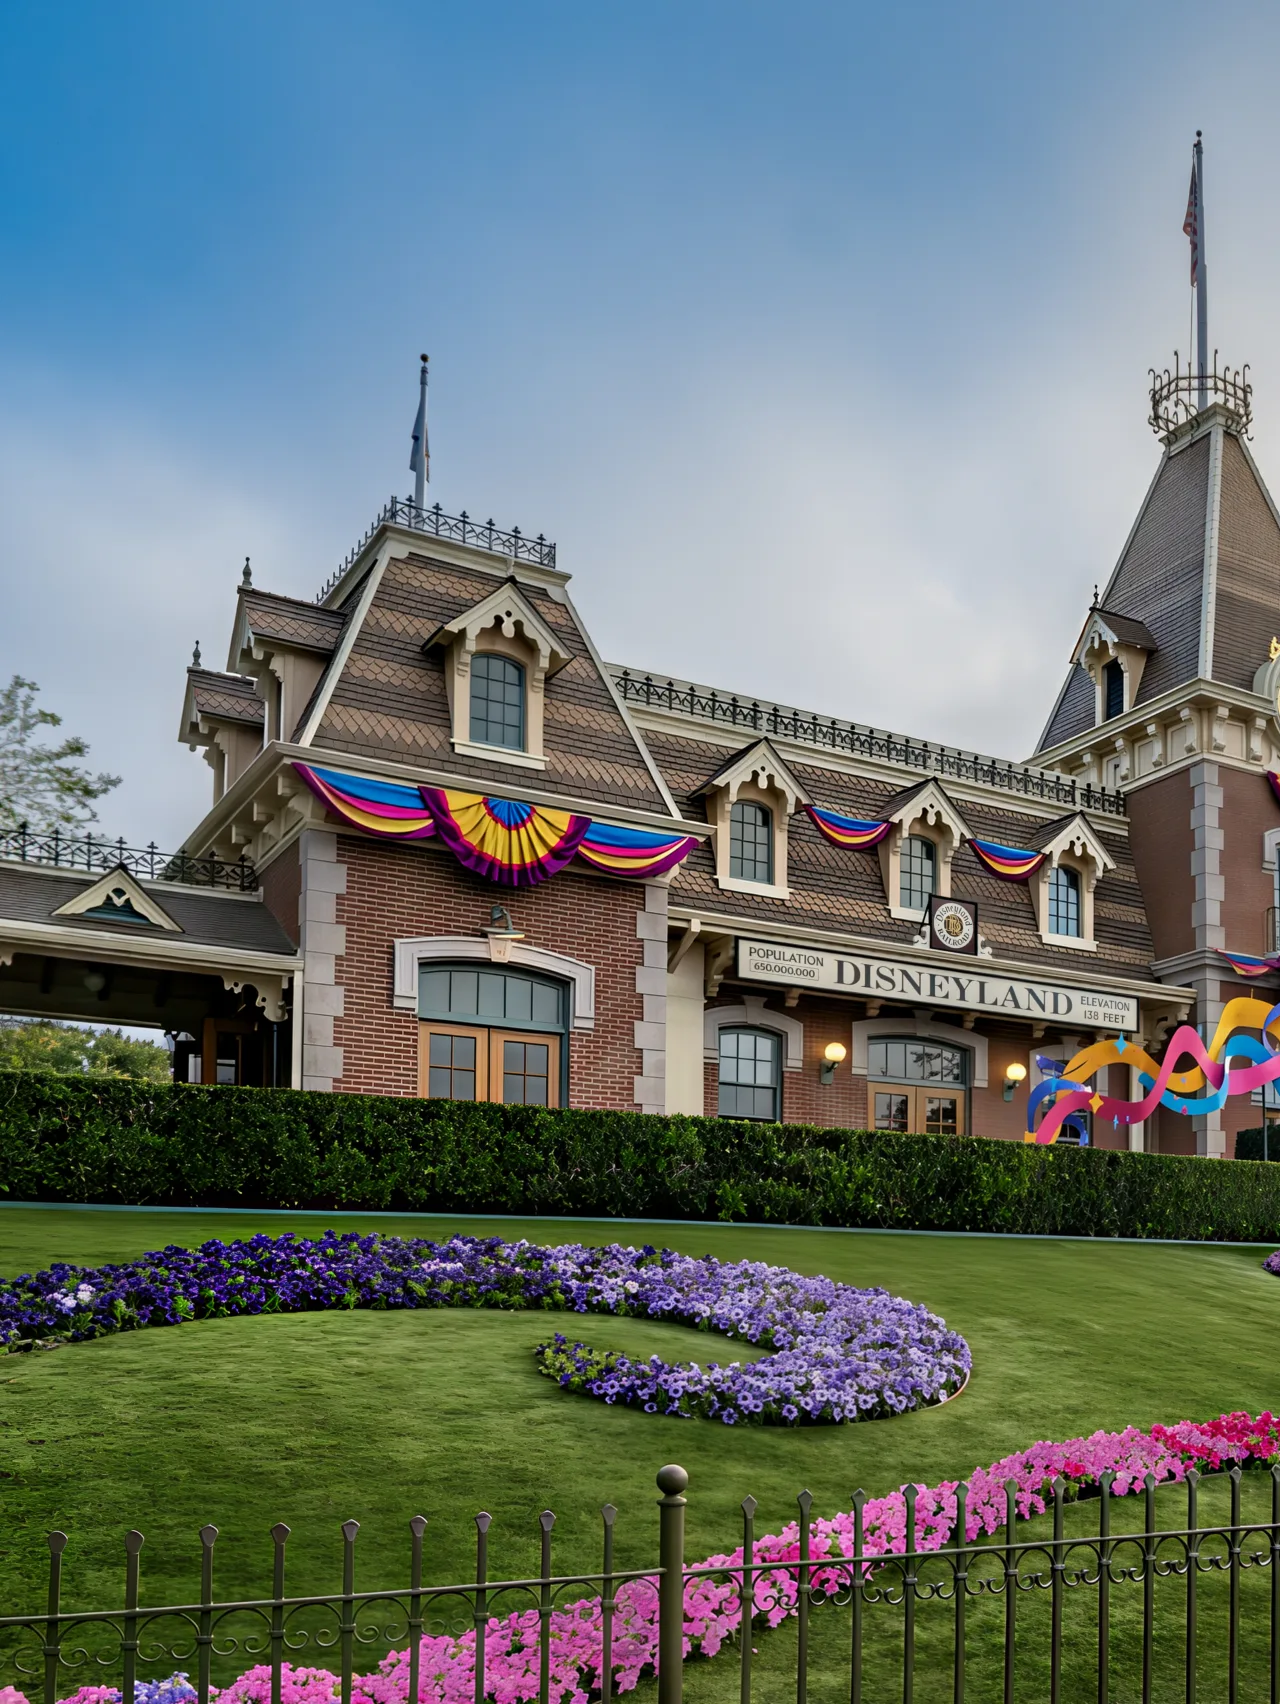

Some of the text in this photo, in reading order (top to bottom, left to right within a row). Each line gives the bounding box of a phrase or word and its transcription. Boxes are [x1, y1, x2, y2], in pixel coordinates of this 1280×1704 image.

[936, 905, 972, 926] Disneyland
[938, 928, 970, 946] RAILROAD
[749, 947, 824, 967] POPULATION
[834, 959, 1073, 1016] DISNEYLAND
[1080, 996, 1130, 1011] ELEVATION
[1084, 1010, 1125, 1024] 138 FEET
